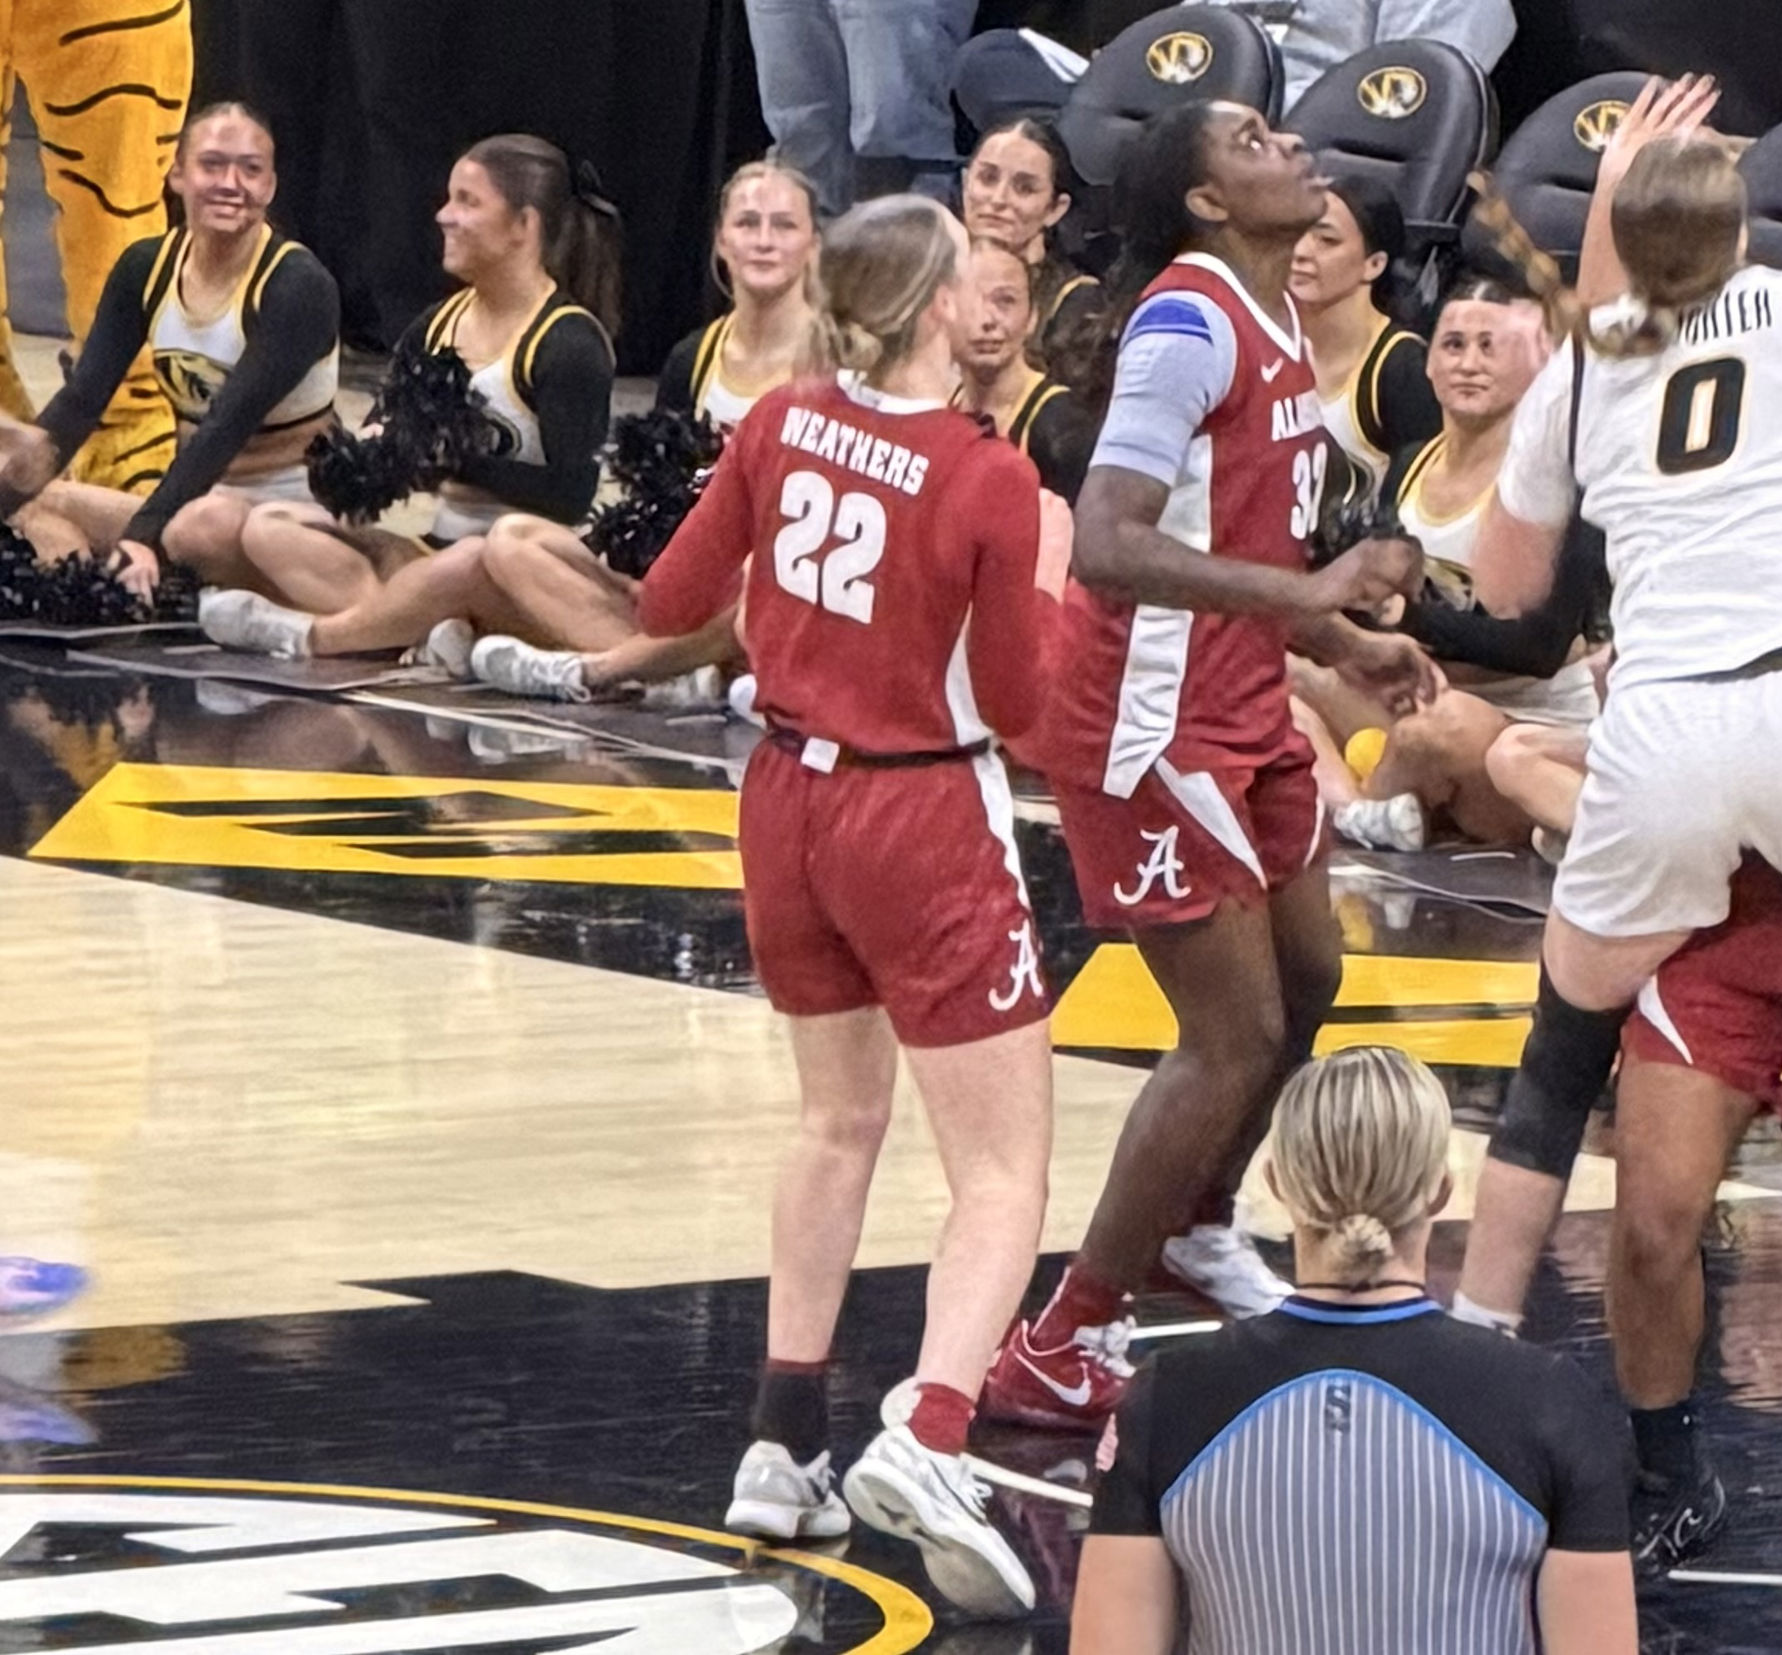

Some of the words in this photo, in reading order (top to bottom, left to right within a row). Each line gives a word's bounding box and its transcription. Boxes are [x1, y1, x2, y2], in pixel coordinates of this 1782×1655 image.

[780, 405, 930, 496] WEATHERS
[1656, 356, 1746, 475] 0
[773, 470, 887, 624] 22
[1113, 825, 1191, 905] A
